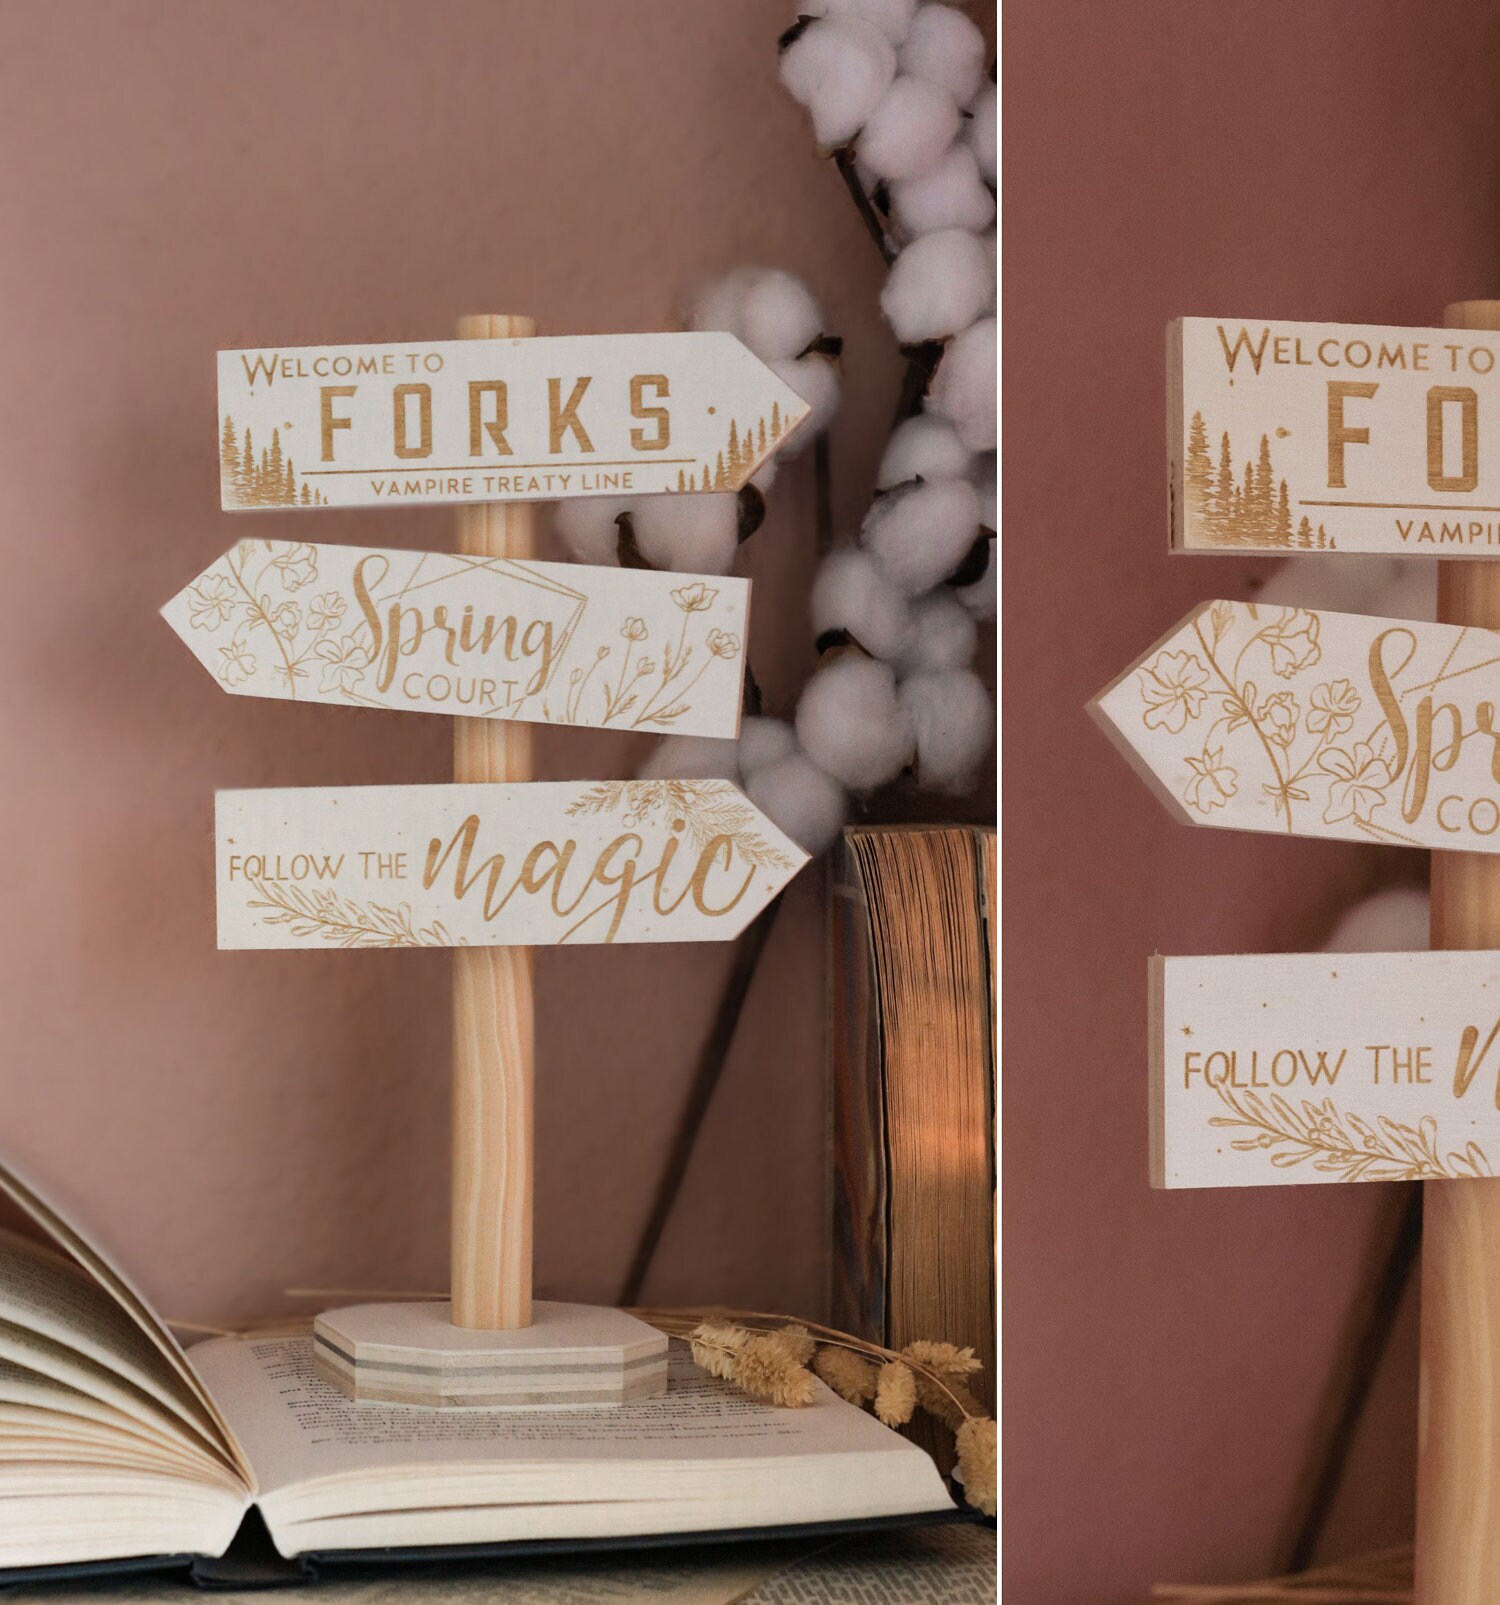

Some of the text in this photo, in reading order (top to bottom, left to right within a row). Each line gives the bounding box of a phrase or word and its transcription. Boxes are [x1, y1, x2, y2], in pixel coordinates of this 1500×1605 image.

[241, 352, 445, 388] WELCOME TO
[1216, 325, 1496, 376] WELCOME TO
[319, 374, 671, 461] FORKS
[370, 471, 634, 496] VAMPIRE TREATY LINE
[353, 554, 560, 695] Spring
[402, 672, 520, 706] COURT
[229, 851, 407, 883] FOLLOW THE
[423, 814, 757, 943] magic
[1183, 1045, 1434, 1090] FOLLOW THE
